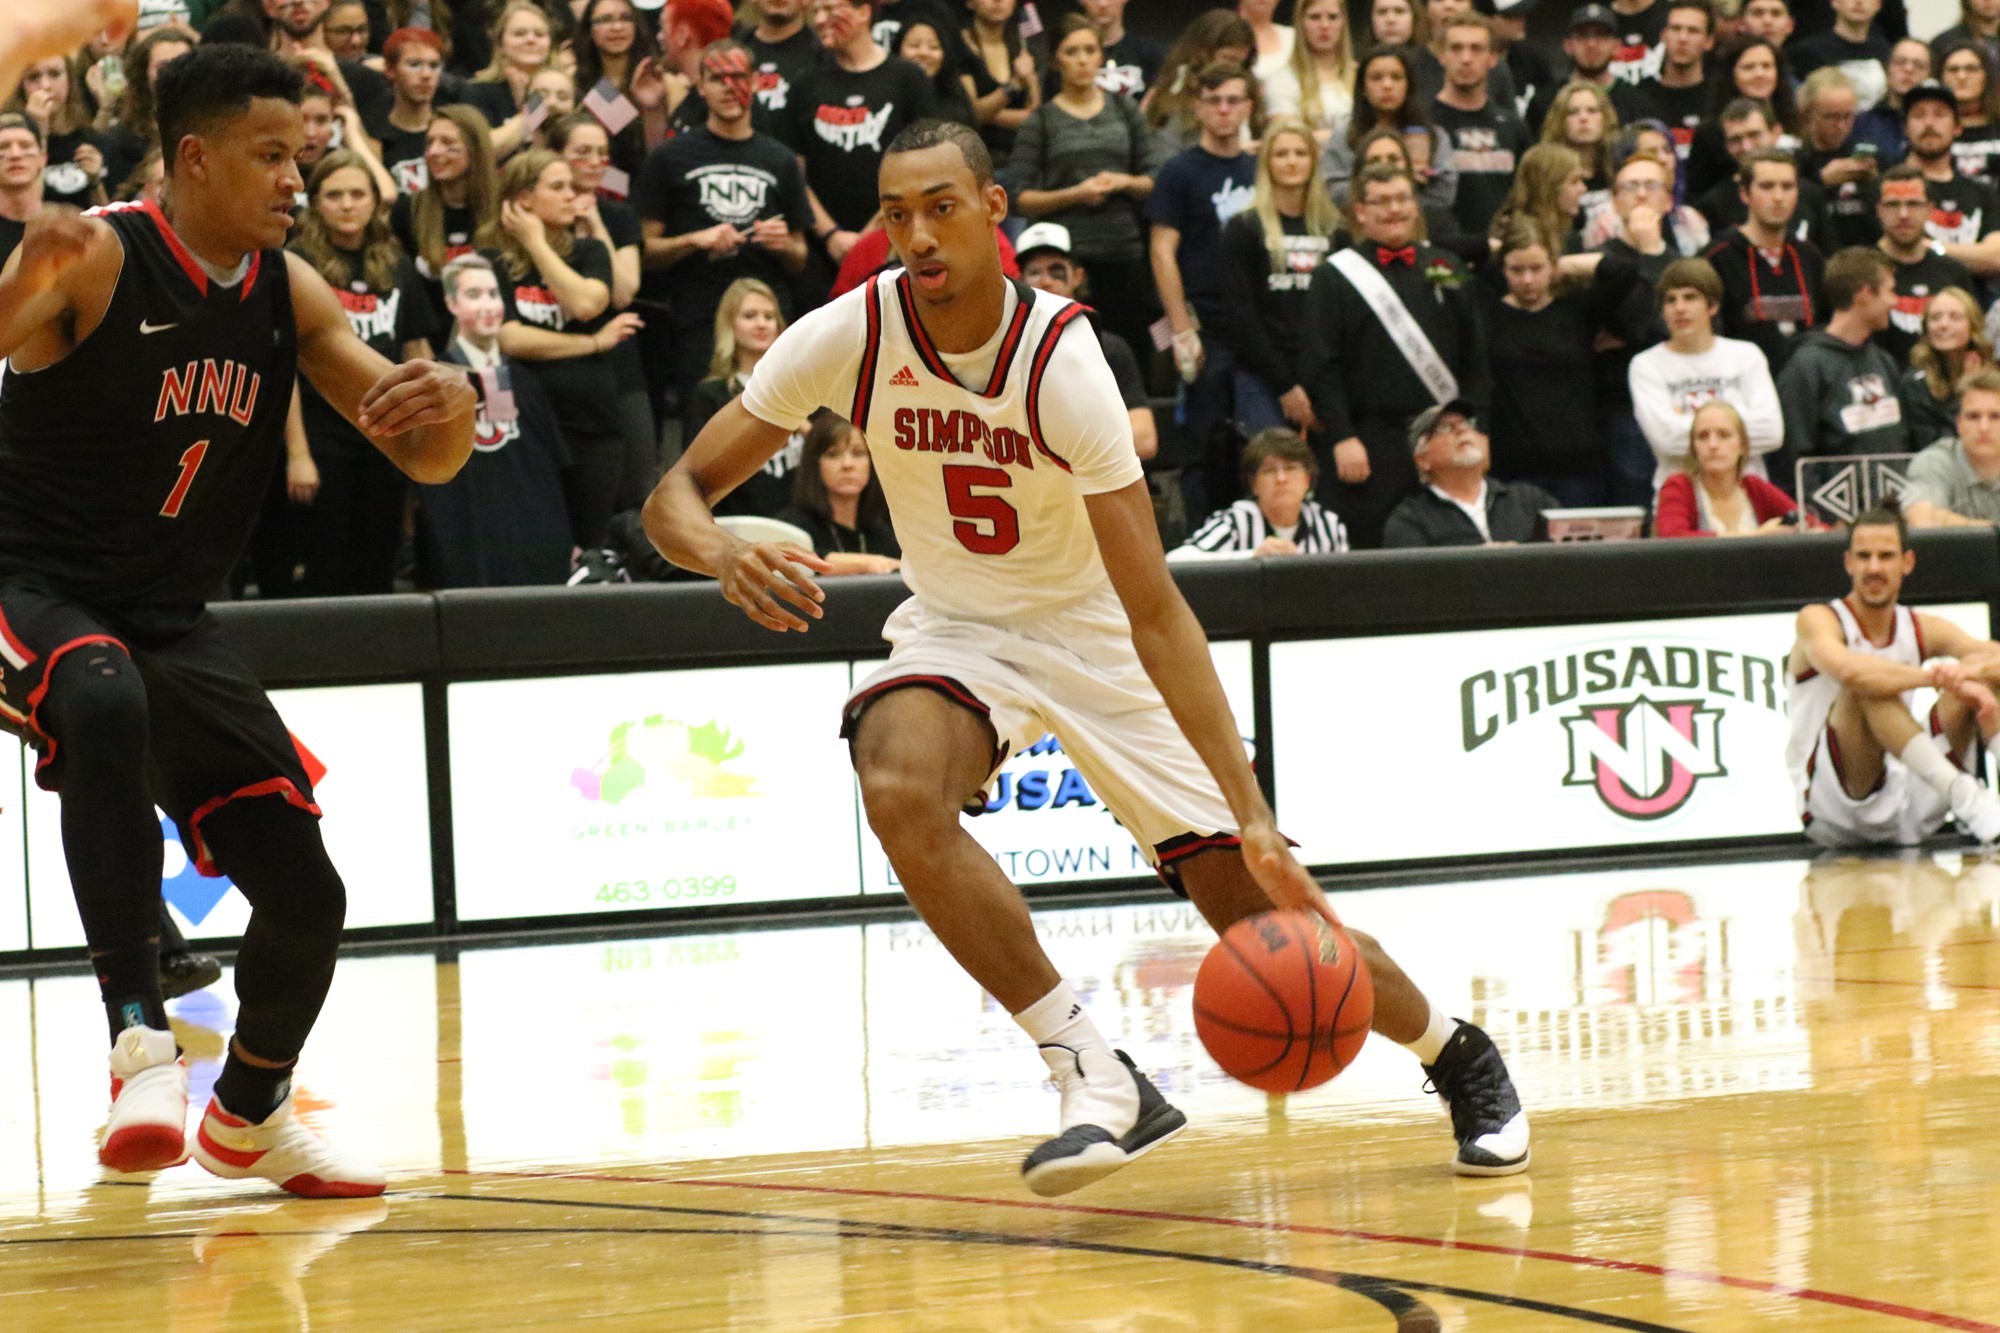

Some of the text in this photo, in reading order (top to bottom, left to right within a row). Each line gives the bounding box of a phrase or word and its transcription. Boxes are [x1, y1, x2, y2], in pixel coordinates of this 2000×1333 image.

[154, 357, 261, 427] NNU
[889, 377, 919, 387] adidas
[894, 407, 1034, 470] SIMPSON
[159, 439, 211, 518] 1
[942, 464, 1020, 556] 5
[1460, 646, 1789, 752] CRUSADER
[571, 823, 649, 840] GREEN
